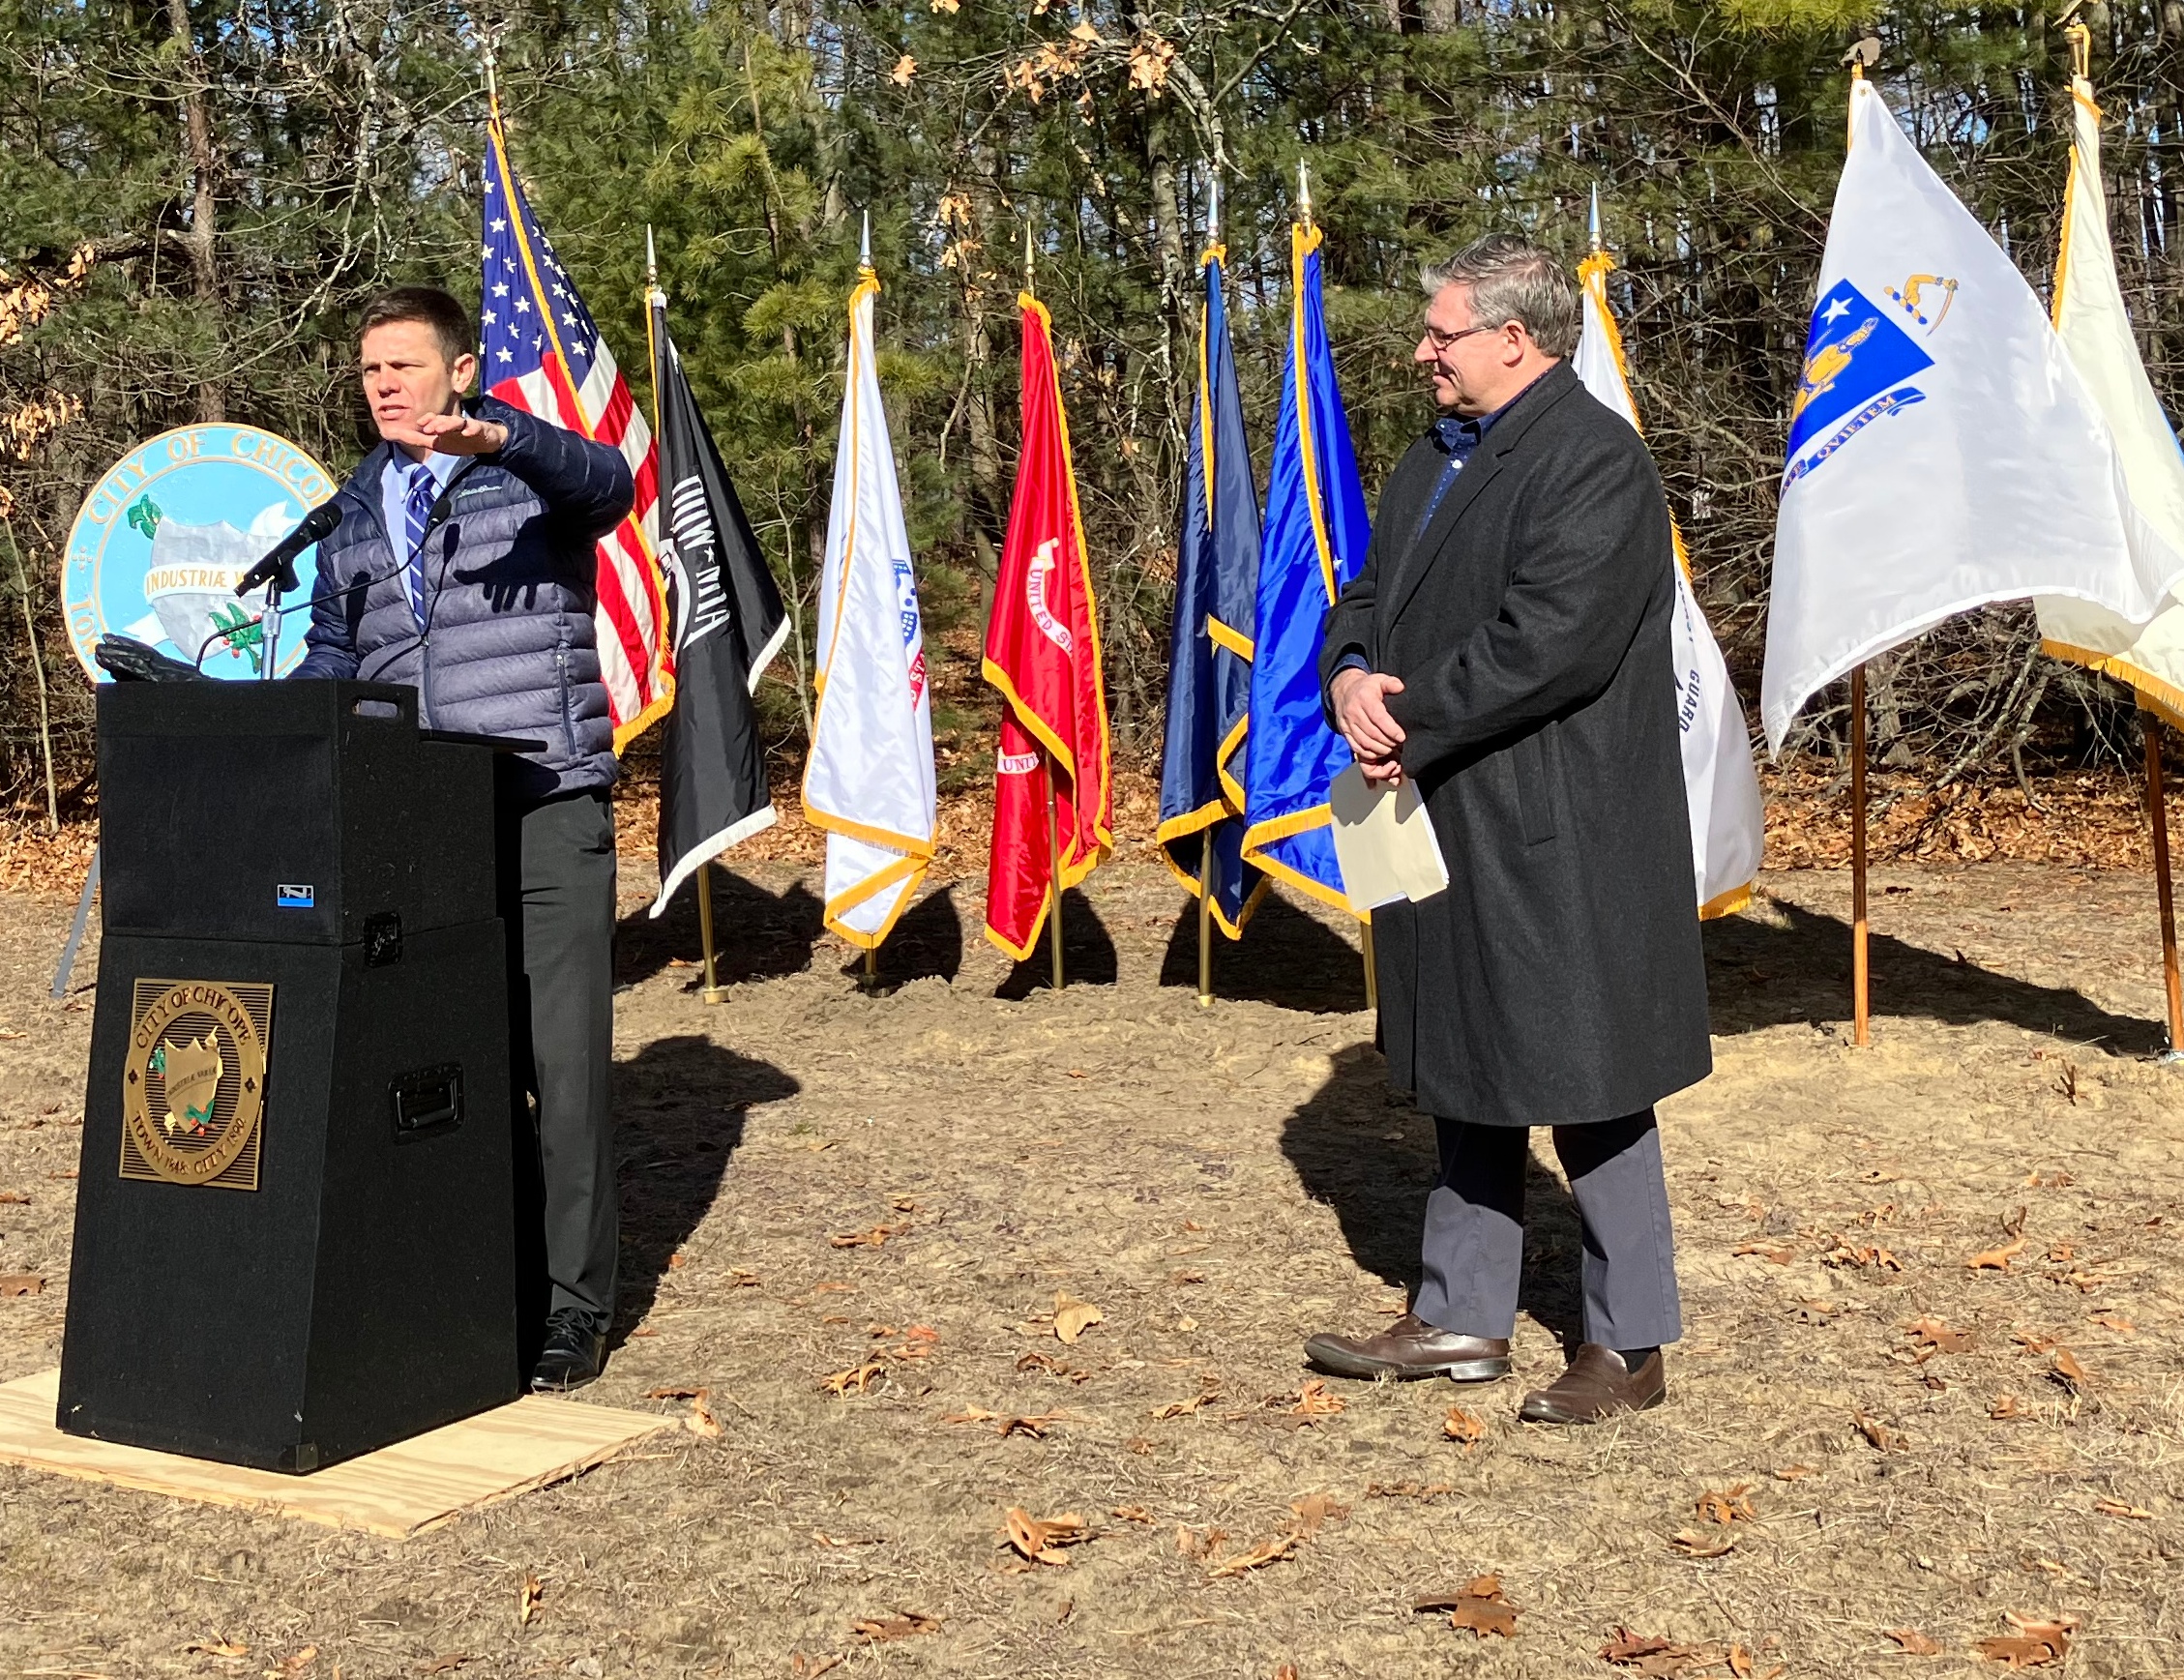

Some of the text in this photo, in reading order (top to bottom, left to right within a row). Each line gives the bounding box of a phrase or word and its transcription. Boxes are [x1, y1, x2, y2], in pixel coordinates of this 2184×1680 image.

[88, 454, 147, 524] CITY
[167, 431, 207, 462] OF
[682, 566, 730, 650] MIA
[1029, 568, 1052, 631] UNITED
[70, 593, 104, 676] TOW
[1678, 669, 1700, 733] GUARD
[136, 998, 170, 1049] CITY
[171, 987, 193, 1008] OF
[133, 1109, 163, 1164] TOWN
[194, 1142, 228, 1175] CITY
